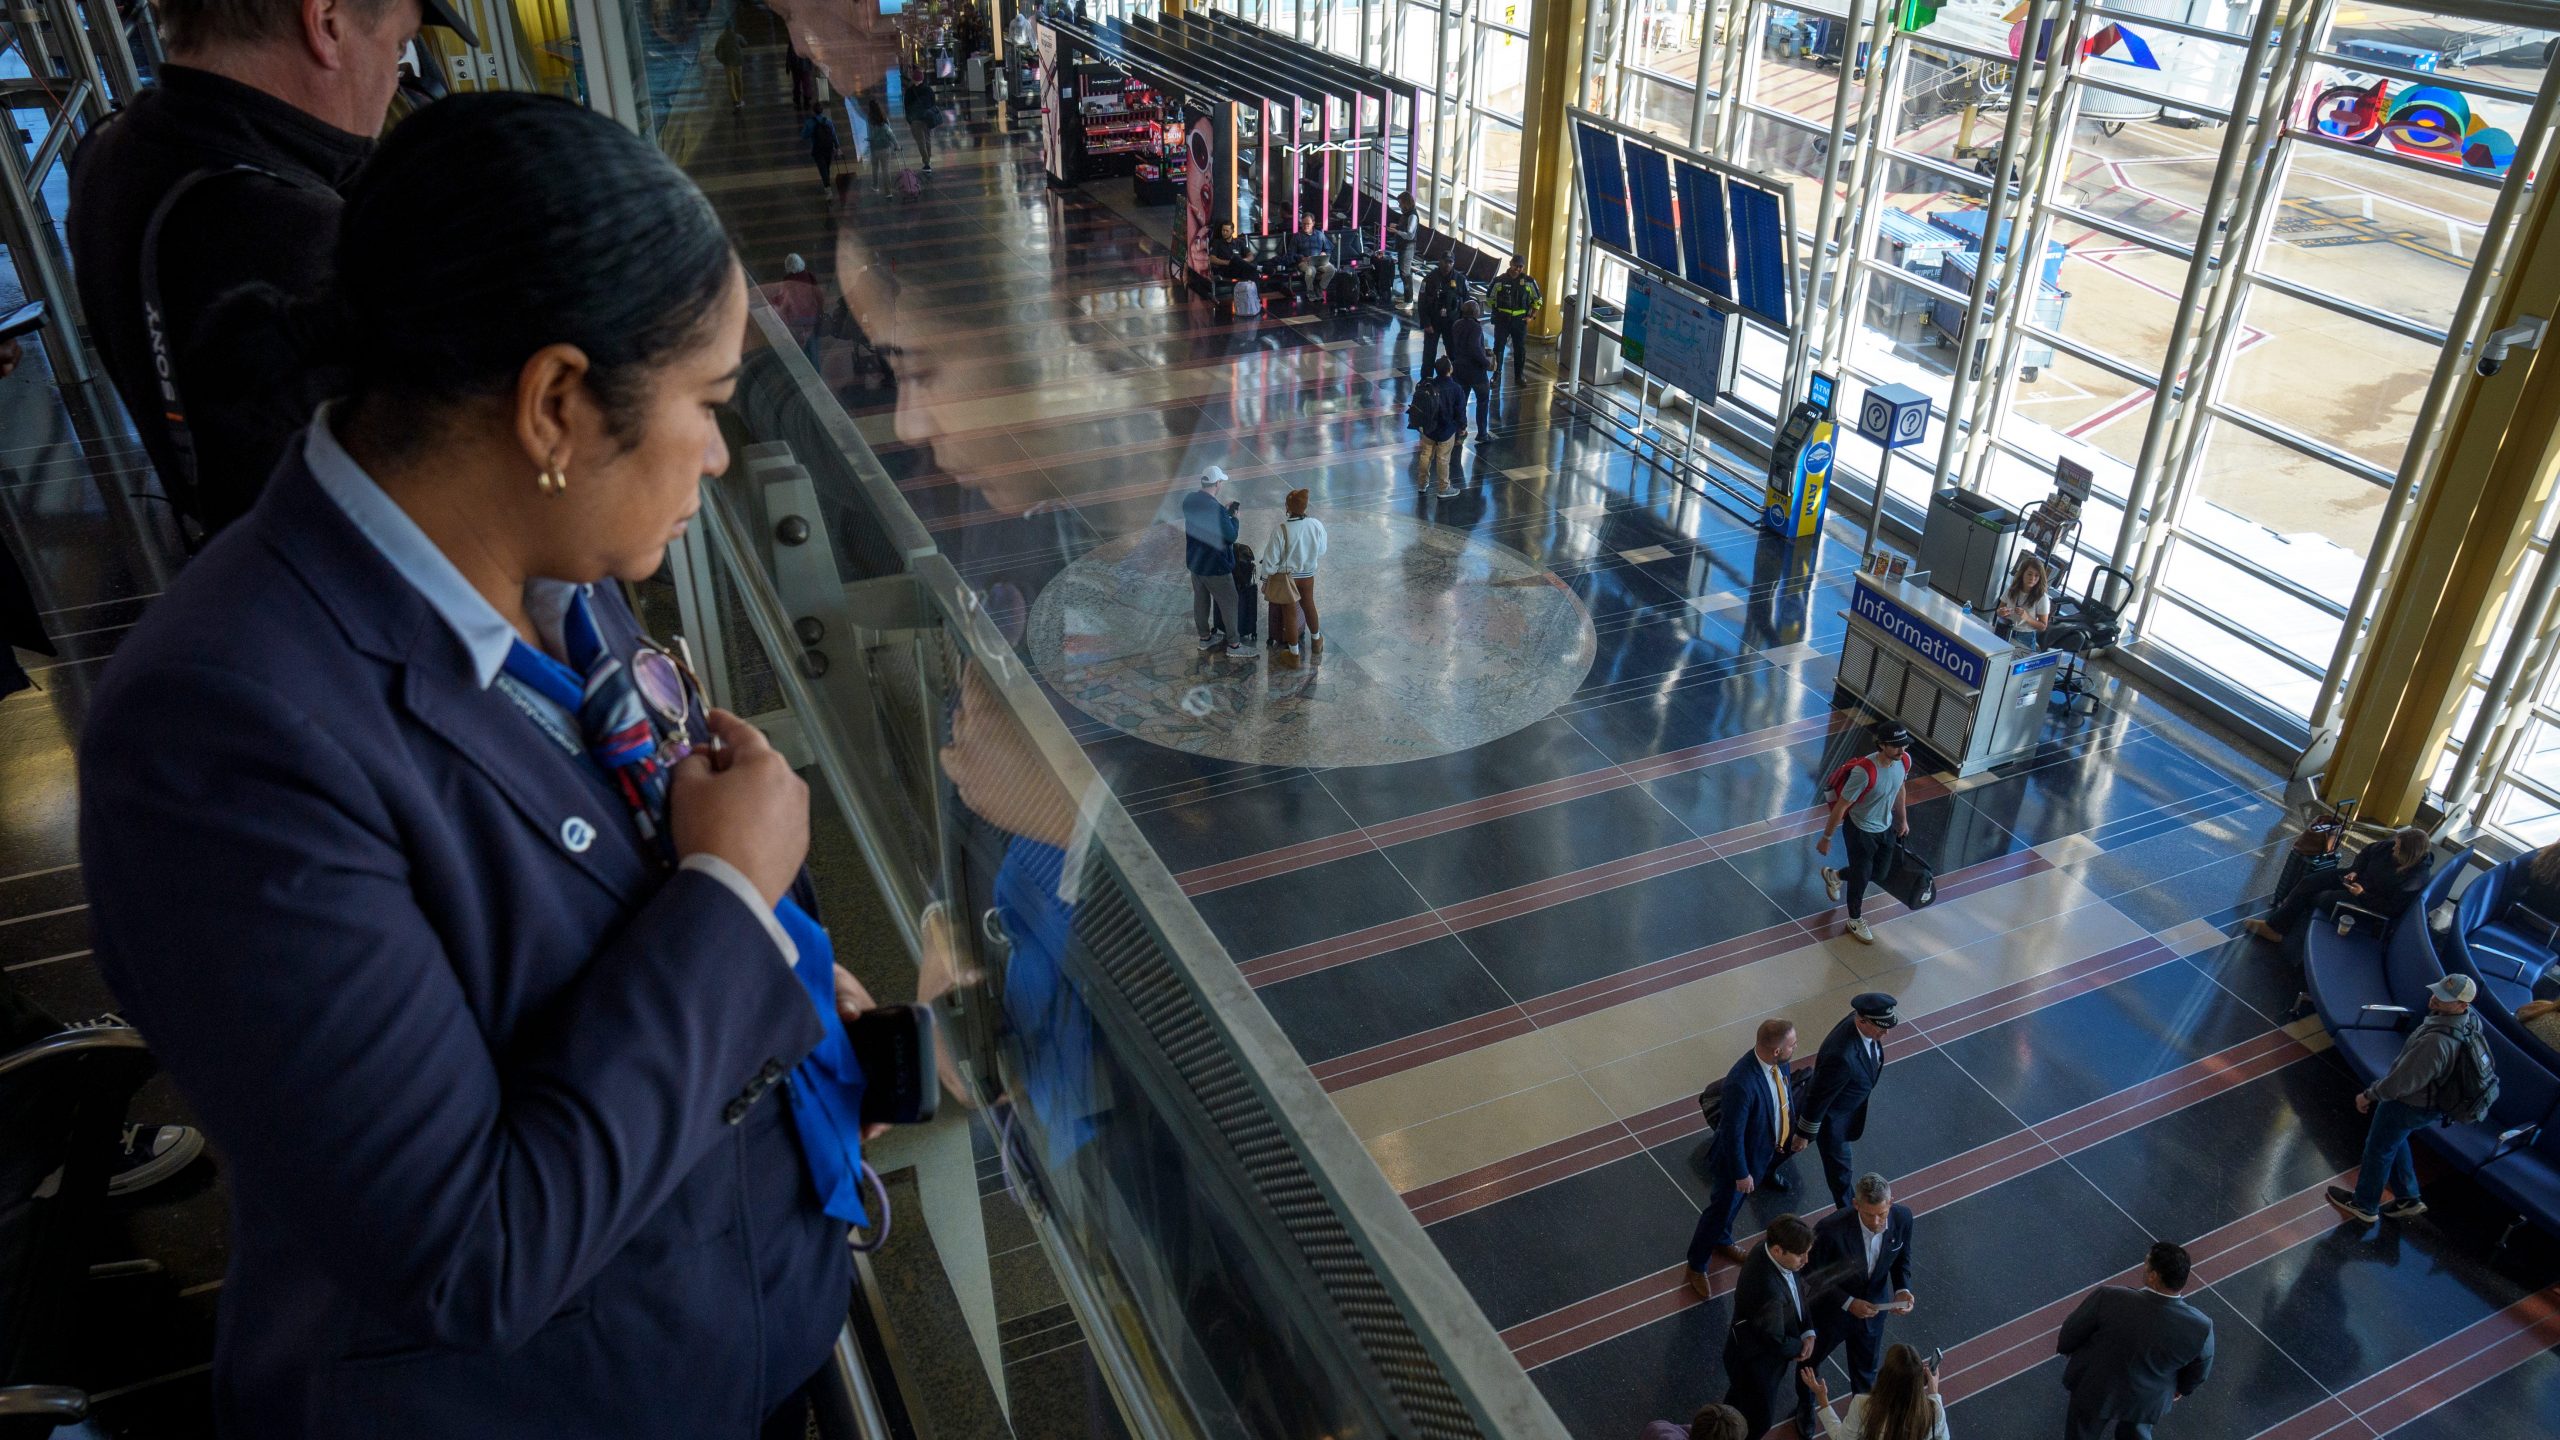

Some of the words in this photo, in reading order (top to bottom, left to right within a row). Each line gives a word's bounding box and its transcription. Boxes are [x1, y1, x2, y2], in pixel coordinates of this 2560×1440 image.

[145, 300, 176, 402] SONY
[1812, 382, 1830, 397] ATM
[1806, 410, 1817, 418] ATM
[1772, 493, 1788, 505] ATM
[1806, 484, 1818, 516] ATM
[1857, 589, 1974, 681] Information
